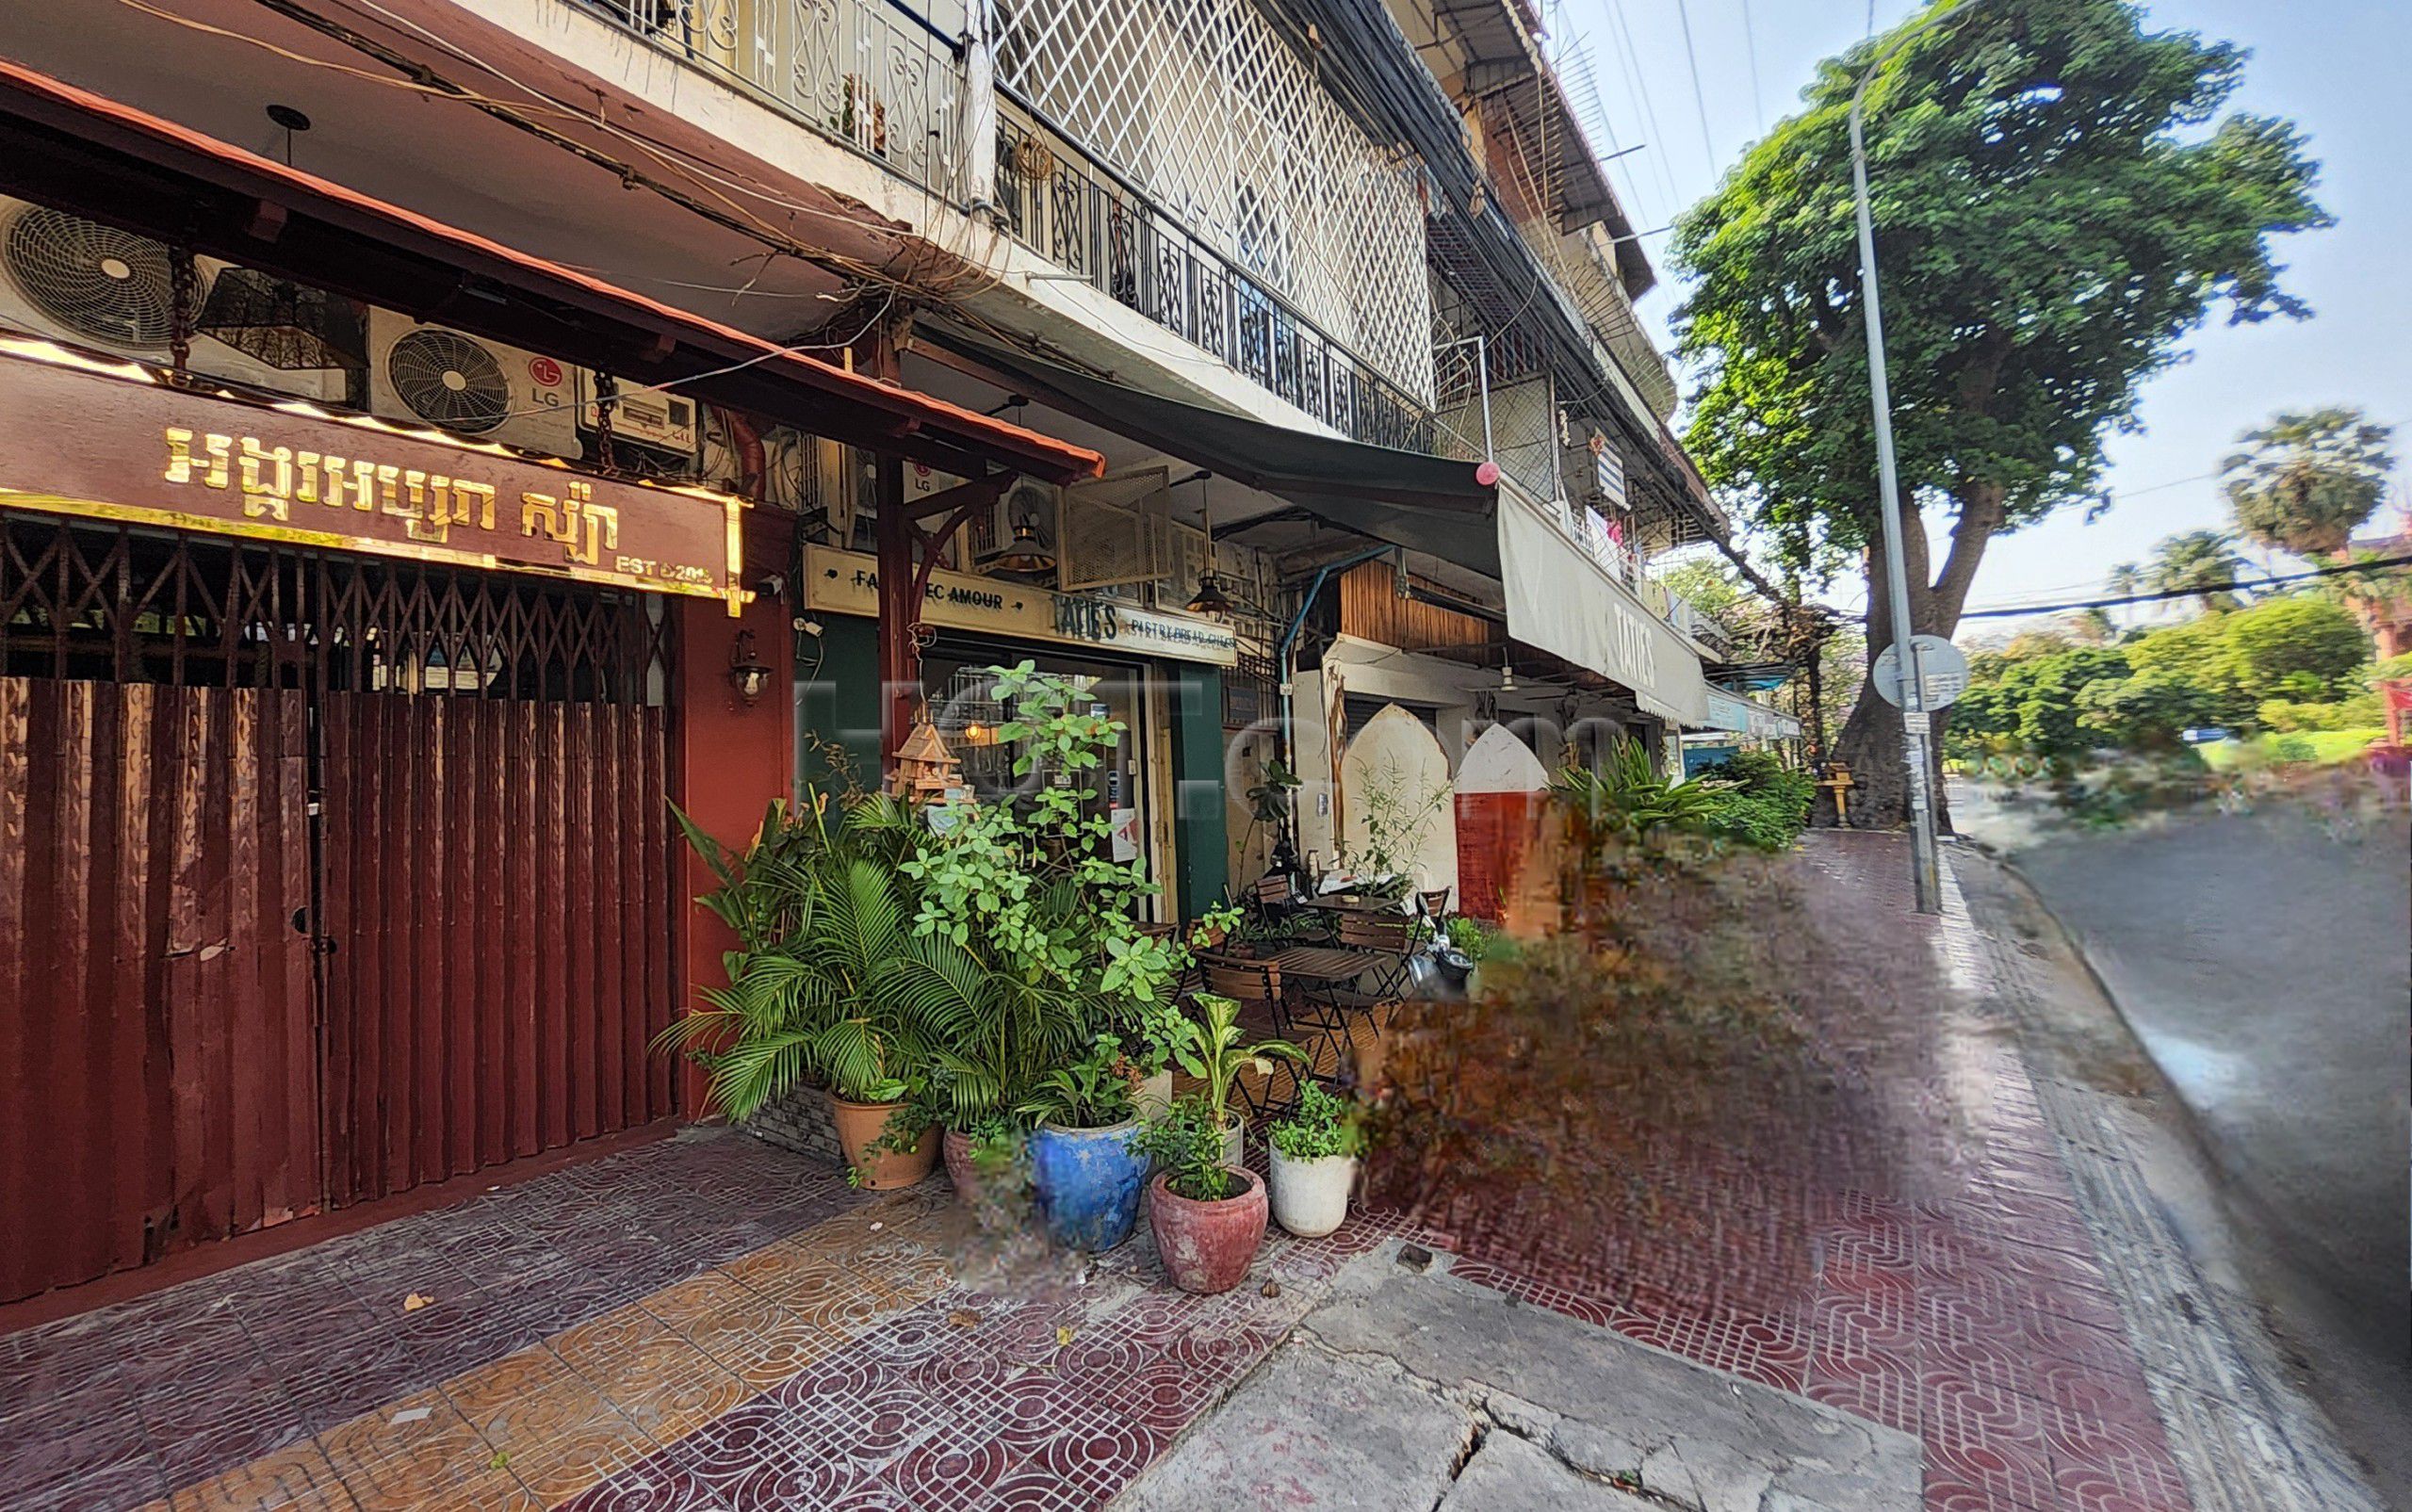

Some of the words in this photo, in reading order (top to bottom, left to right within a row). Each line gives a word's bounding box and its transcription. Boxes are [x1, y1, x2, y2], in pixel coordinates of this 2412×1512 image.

[531, 388, 559, 406] LG
[915, 478, 930, 492] LG
[948, 587, 1002, 610] AMOUR
